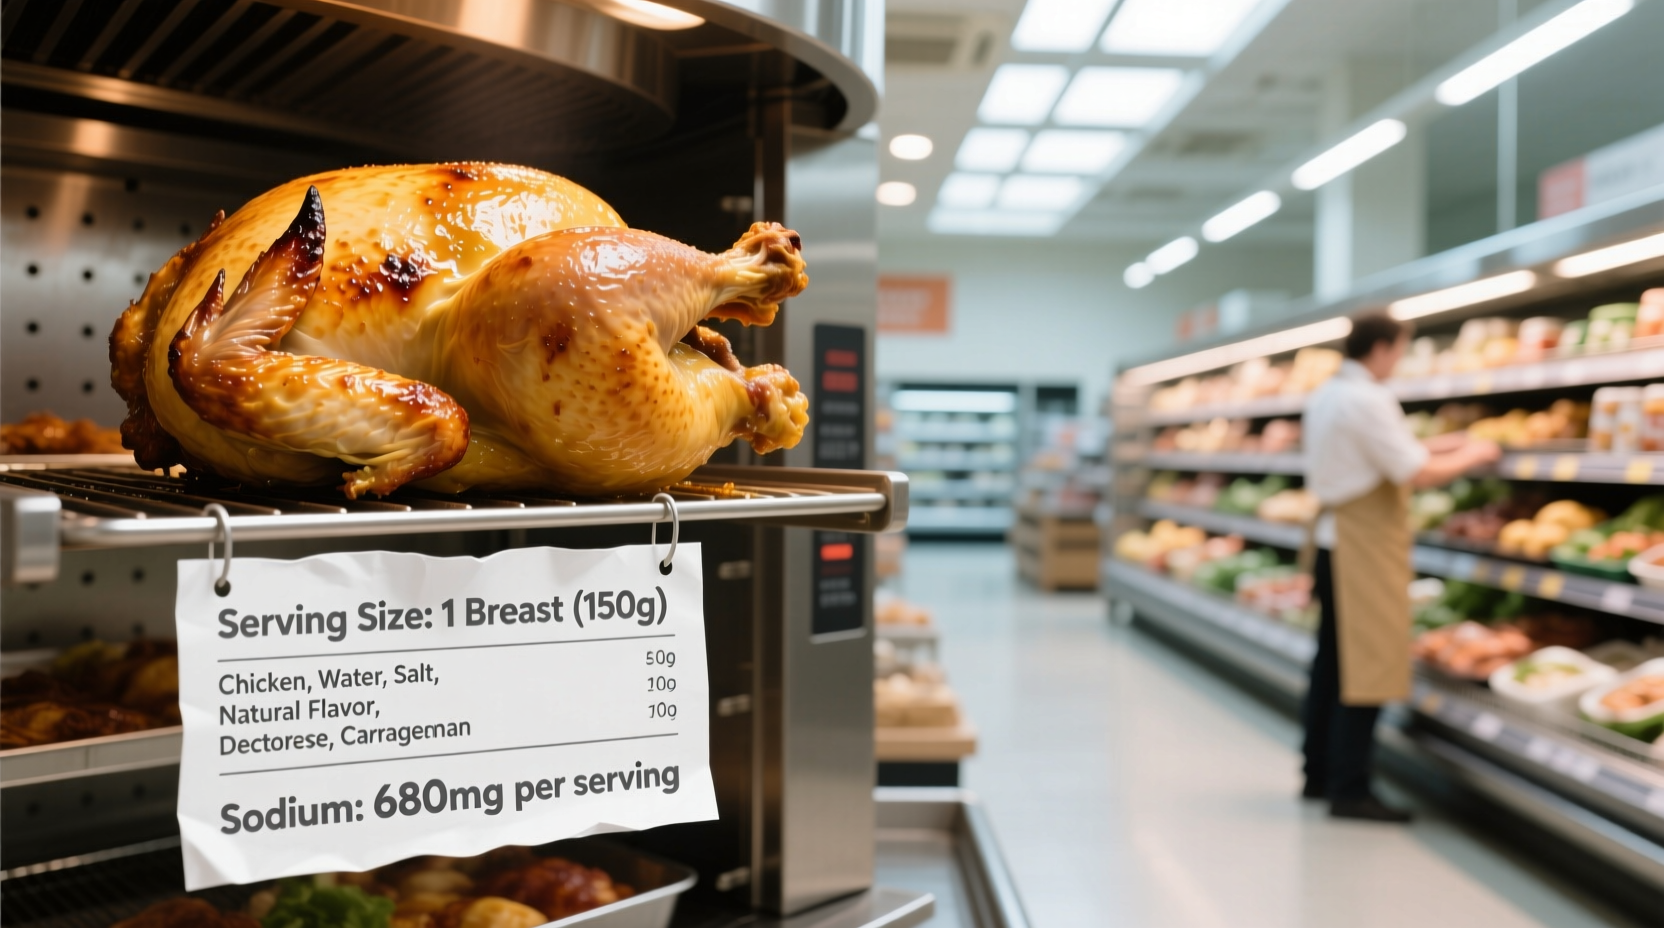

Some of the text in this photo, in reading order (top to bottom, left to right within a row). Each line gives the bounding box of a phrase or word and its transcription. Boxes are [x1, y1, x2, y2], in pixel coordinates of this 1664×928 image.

[217, 585, 668, 643] Serving Size: 1 Breast (150g)
[646, 649, 676, 668] 50g
[218, 662, 439, 695] Chicken, Water, Salt,
[647, 675, 677, 692] 10g
[219, 698, 380, 726] Natural Flavor,
[219, 732, 334, 756] Dectorese,
[220, 760, 680, 835] Sodium: 680mg per serving
